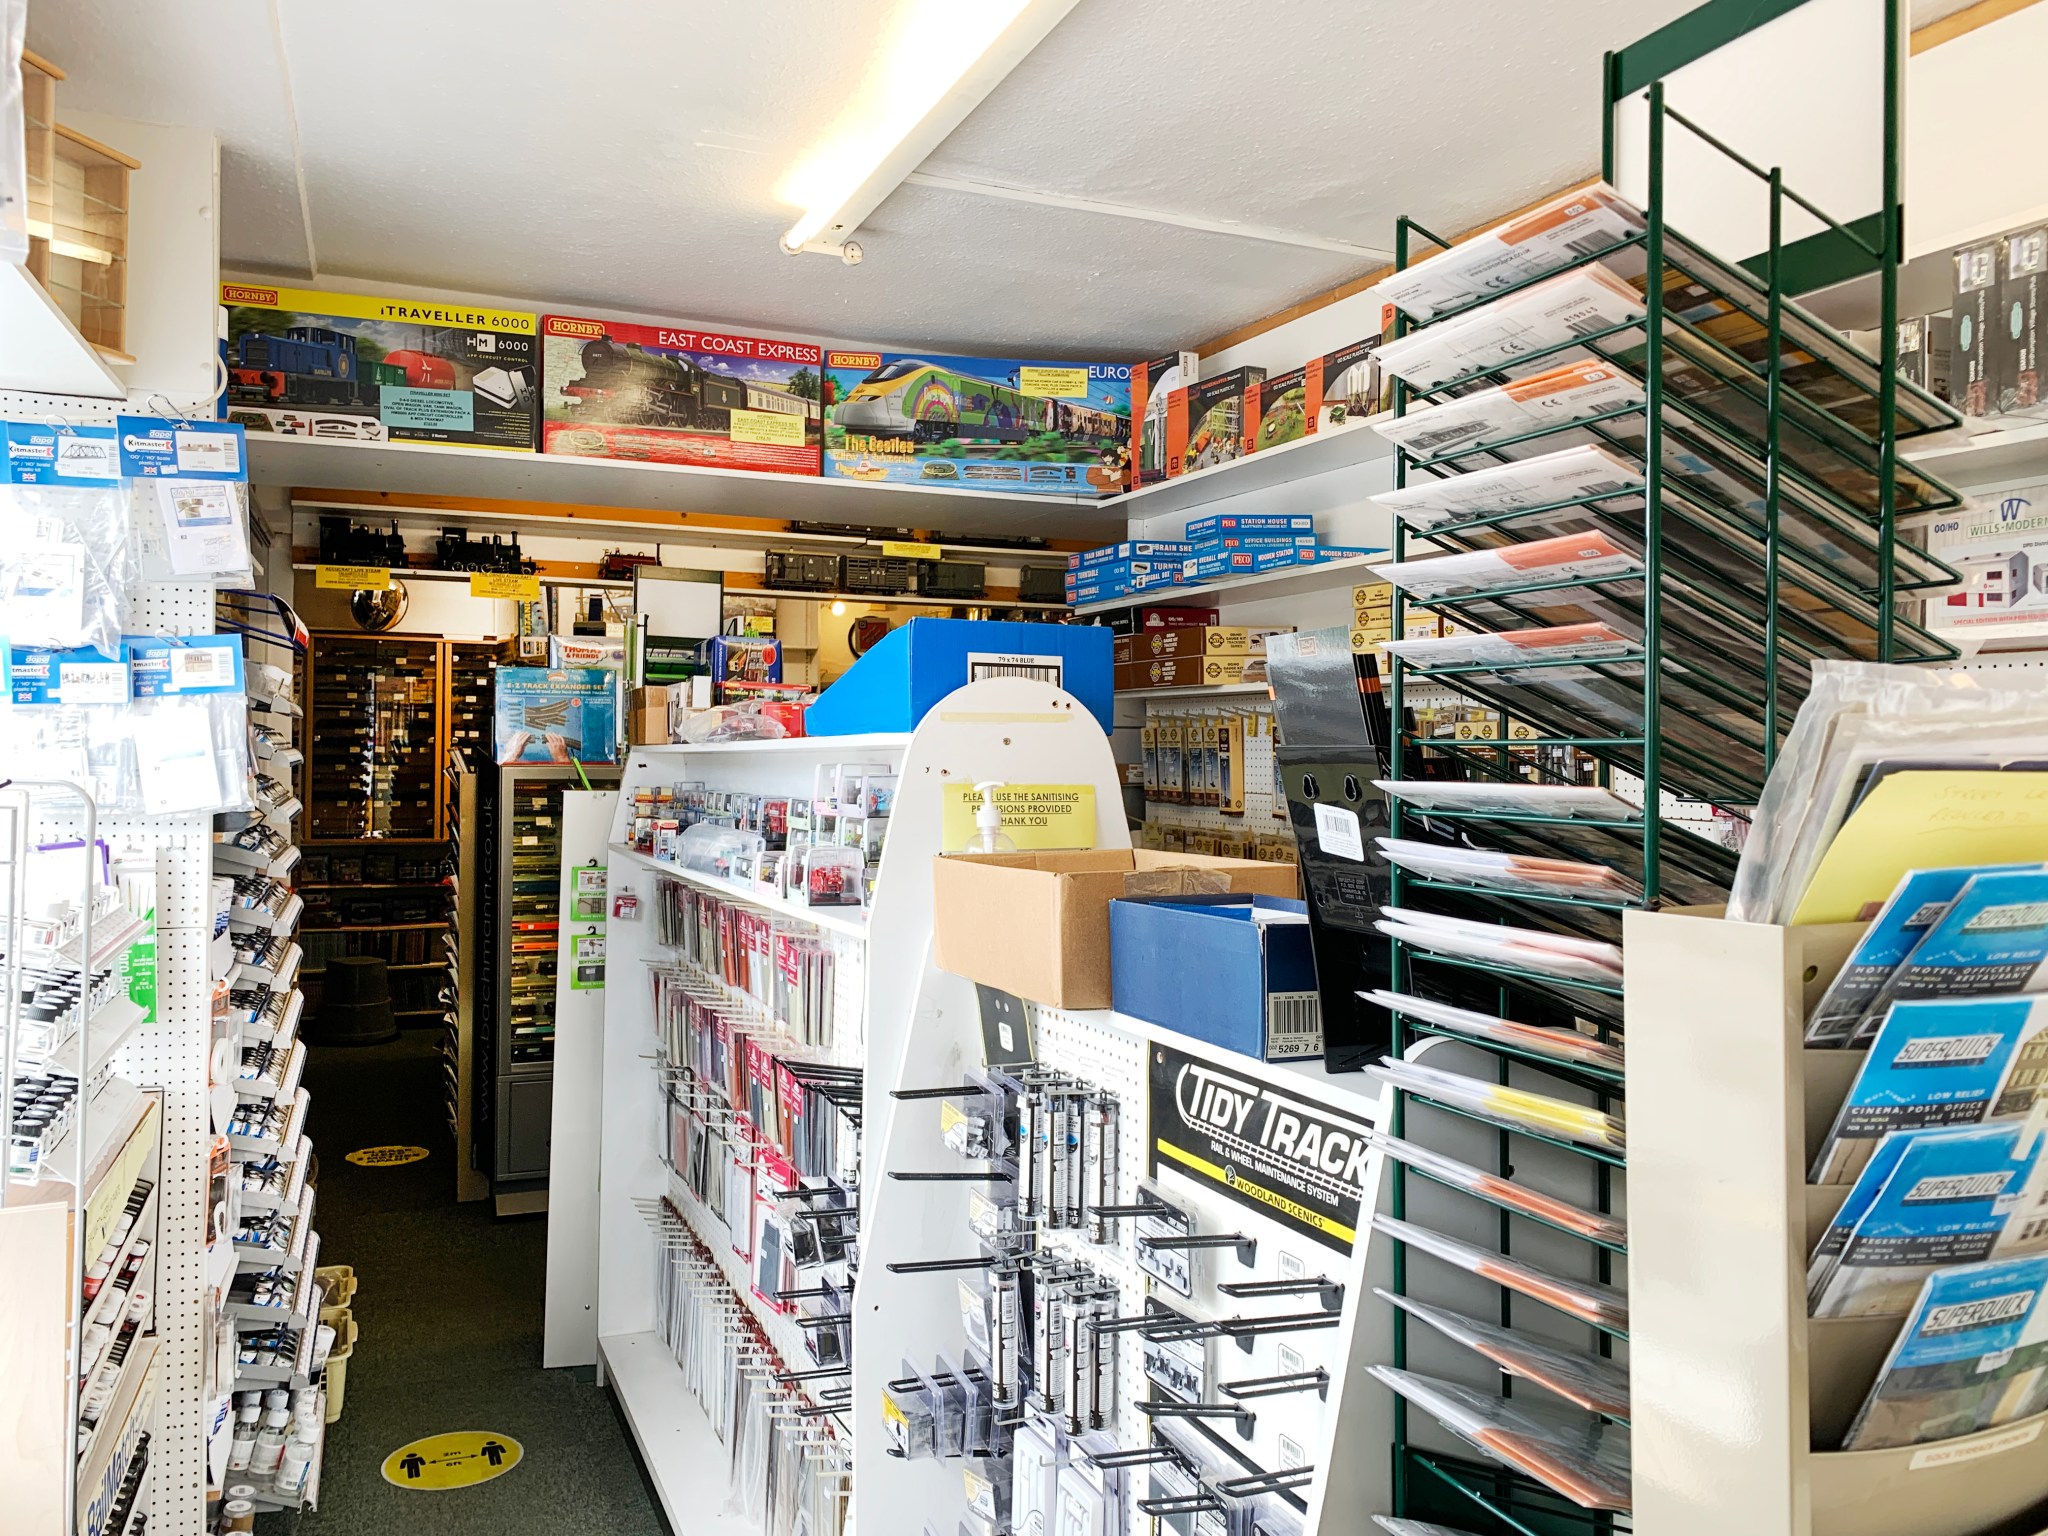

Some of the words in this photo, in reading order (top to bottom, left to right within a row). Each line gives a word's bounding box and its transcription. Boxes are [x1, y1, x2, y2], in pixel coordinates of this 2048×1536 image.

[229, 290, 273, 303] HORNBY
[491, 316, 530, 330] 6000
[553, 321, 600, 335] HORNBY
[498, 340, 529, 351] 6000
[659, 331, 697, 348] EAST
[701, 337, 754, 355] COAST
[759, 343, 818, 362] EXPRESS
[832, 354, 876, 366] HORNBY
[150, 430, 173, 439] dapol
[30, 436, 55, 445] dapol
[128, 439, 166, 448] Kitmaster
[845, 435, 867, 451] The
[1222, 519, 1236, 527] PECO
[1224, 539, 1239, 547] PECO
[1258, 551, 1275, 561] WOODEN
[1275, 548, 1294, 558] STATION
[1300, 550, 1314, 558] PECO
[1234, 555, 1250, 565] PECO
[1078, 568, 1099, 579] TURNTABLE
[1078, 586, 1099, 596] TURNTABLE
[26, 655, 50, 663] dapol
[146, 649, 169, 658] dapol
[963, 792, 993, 801] PLEA
[996, 793, 1012, 801] USE
[1014, 793, 1029, 801] THE
[1031, 792, 1079, 801] SANITISING
[1028, 805, 1072, 813] PROVIDED
[1001, 817, 1026, 825] HANK
[1029, 817, 1048, 825] YOU
[1987, 951, 2010, 960] LOW
[2012, 949, 2042, 959] RELIEF
[1963, 966, 2012, 974] OFFICES
[1955, 972, 2028, 982] RESTAURANT
[1278, 1044, 1300, 1053] 5269
[1898, 1035, 2000, 1061] SUPERQUICK
[1928, 1092, 1952, 1100] LOW
[1954, 1089, 1986, 1099] RELIEF
[1851, 1106, 1904, 1115] CINEMA,
[1907, 1104, 1937, 1113] POST
[1944, 1102, 1984, 1111] OFFICE
[1924, 1113, 1943, 1121] and
[1950, 1109, 1981, 1120] SHOP
[1189, 1064, 1260, 1134] TIDY
[1260, 1090, 1373, 1187] TRACK
[1211, 1141, 1224, 1158] RAIL
[1231, 1149, 1254, 1169] WHEEL
[1255, 1160, 1306, 1193] MAINTENANCE
[1306, 1184, 1339, 1207] SYSTEM
[1909, 1174, 2012, 1199] SUPERQUICK
[1236, 1178, 1287, 1210] WOODLAND
[1287, 1202, 1324, 1228] SCENICS
[1936, 1223, 1961, 1232] LOW
[1963, 1221, 1996, 1230] RELIEF
[1861, 1236, 1911, 1245] REGENCY
[1917, 1235, 1954, 1244] PERIOD
[1959, 1233, 1992, 1241] SHOPS
[1969, 1280, 1987, 1288] LOW
[1991, 1274, 2018, 1285] RELIEF
[1926, 1293, 2030, 1329] SUPERQUICK
